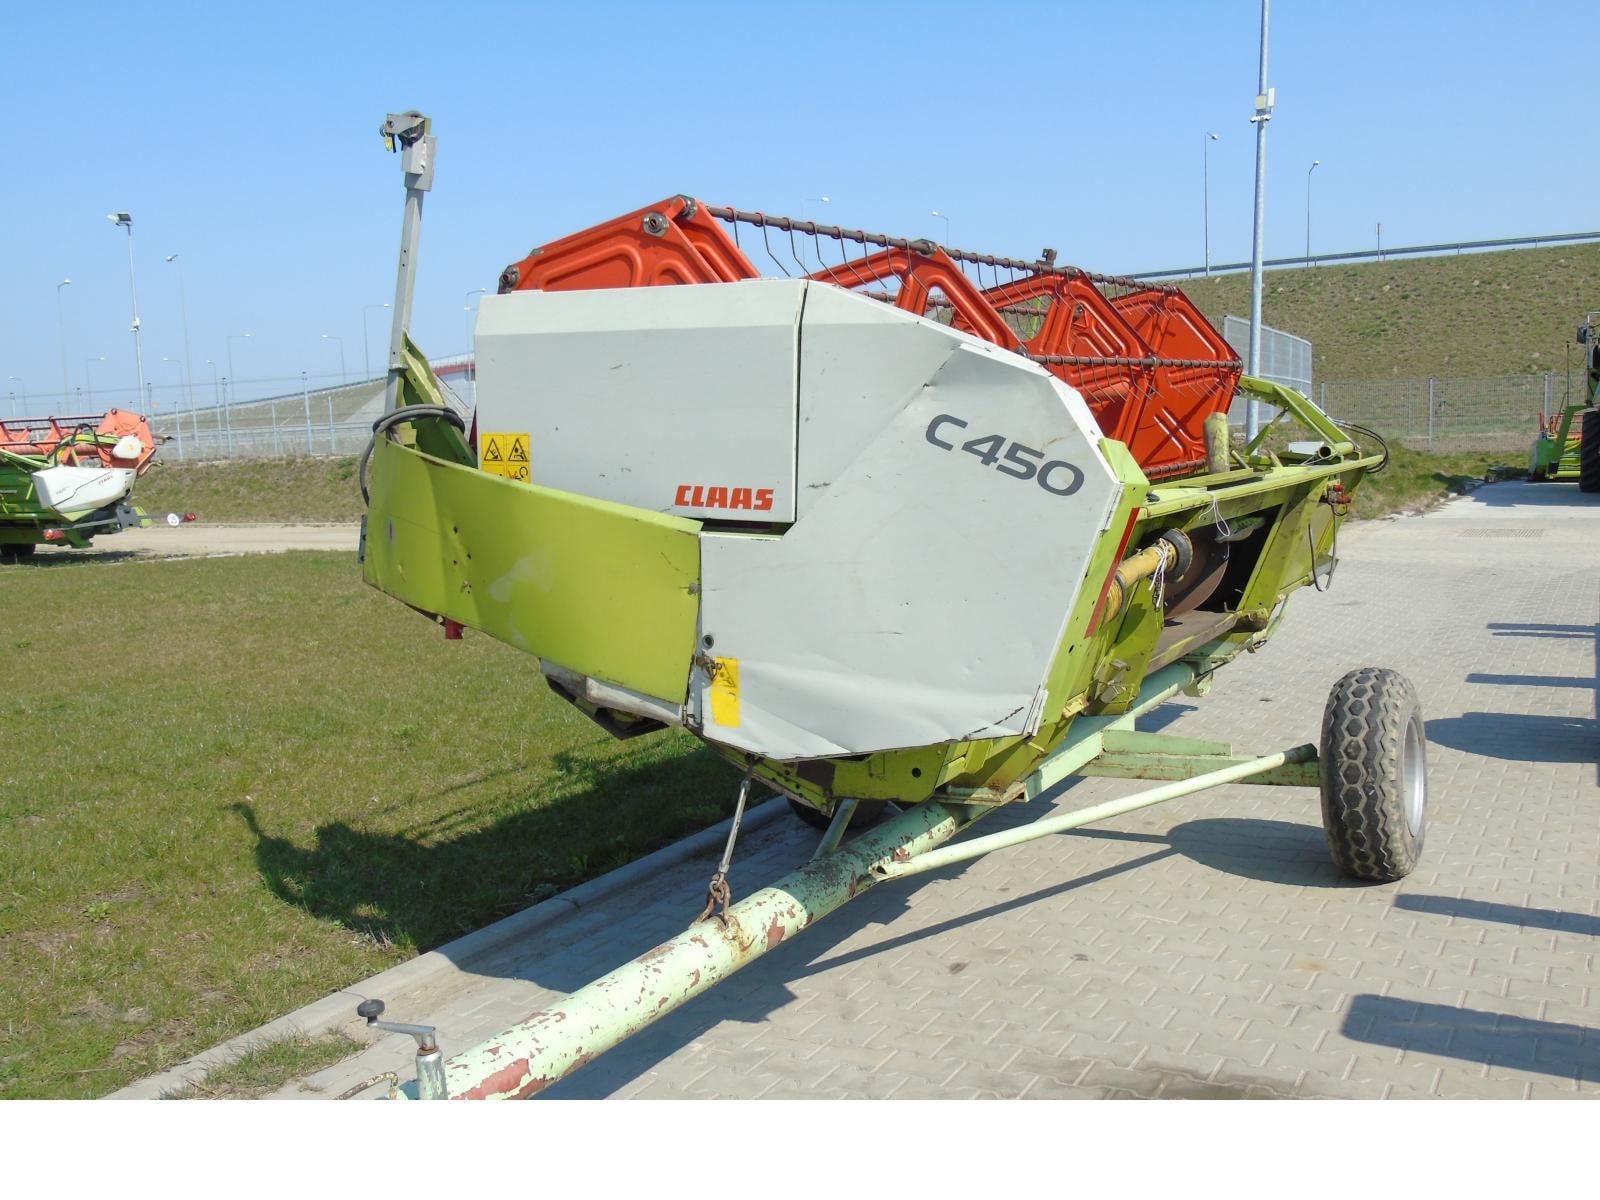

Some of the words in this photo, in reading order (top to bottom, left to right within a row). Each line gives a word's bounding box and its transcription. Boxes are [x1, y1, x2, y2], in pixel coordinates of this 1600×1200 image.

[926, 414, 968, 451] C
[961, 434, 1084, 496] 450
[675, 485, 774, 511] CLAAS
